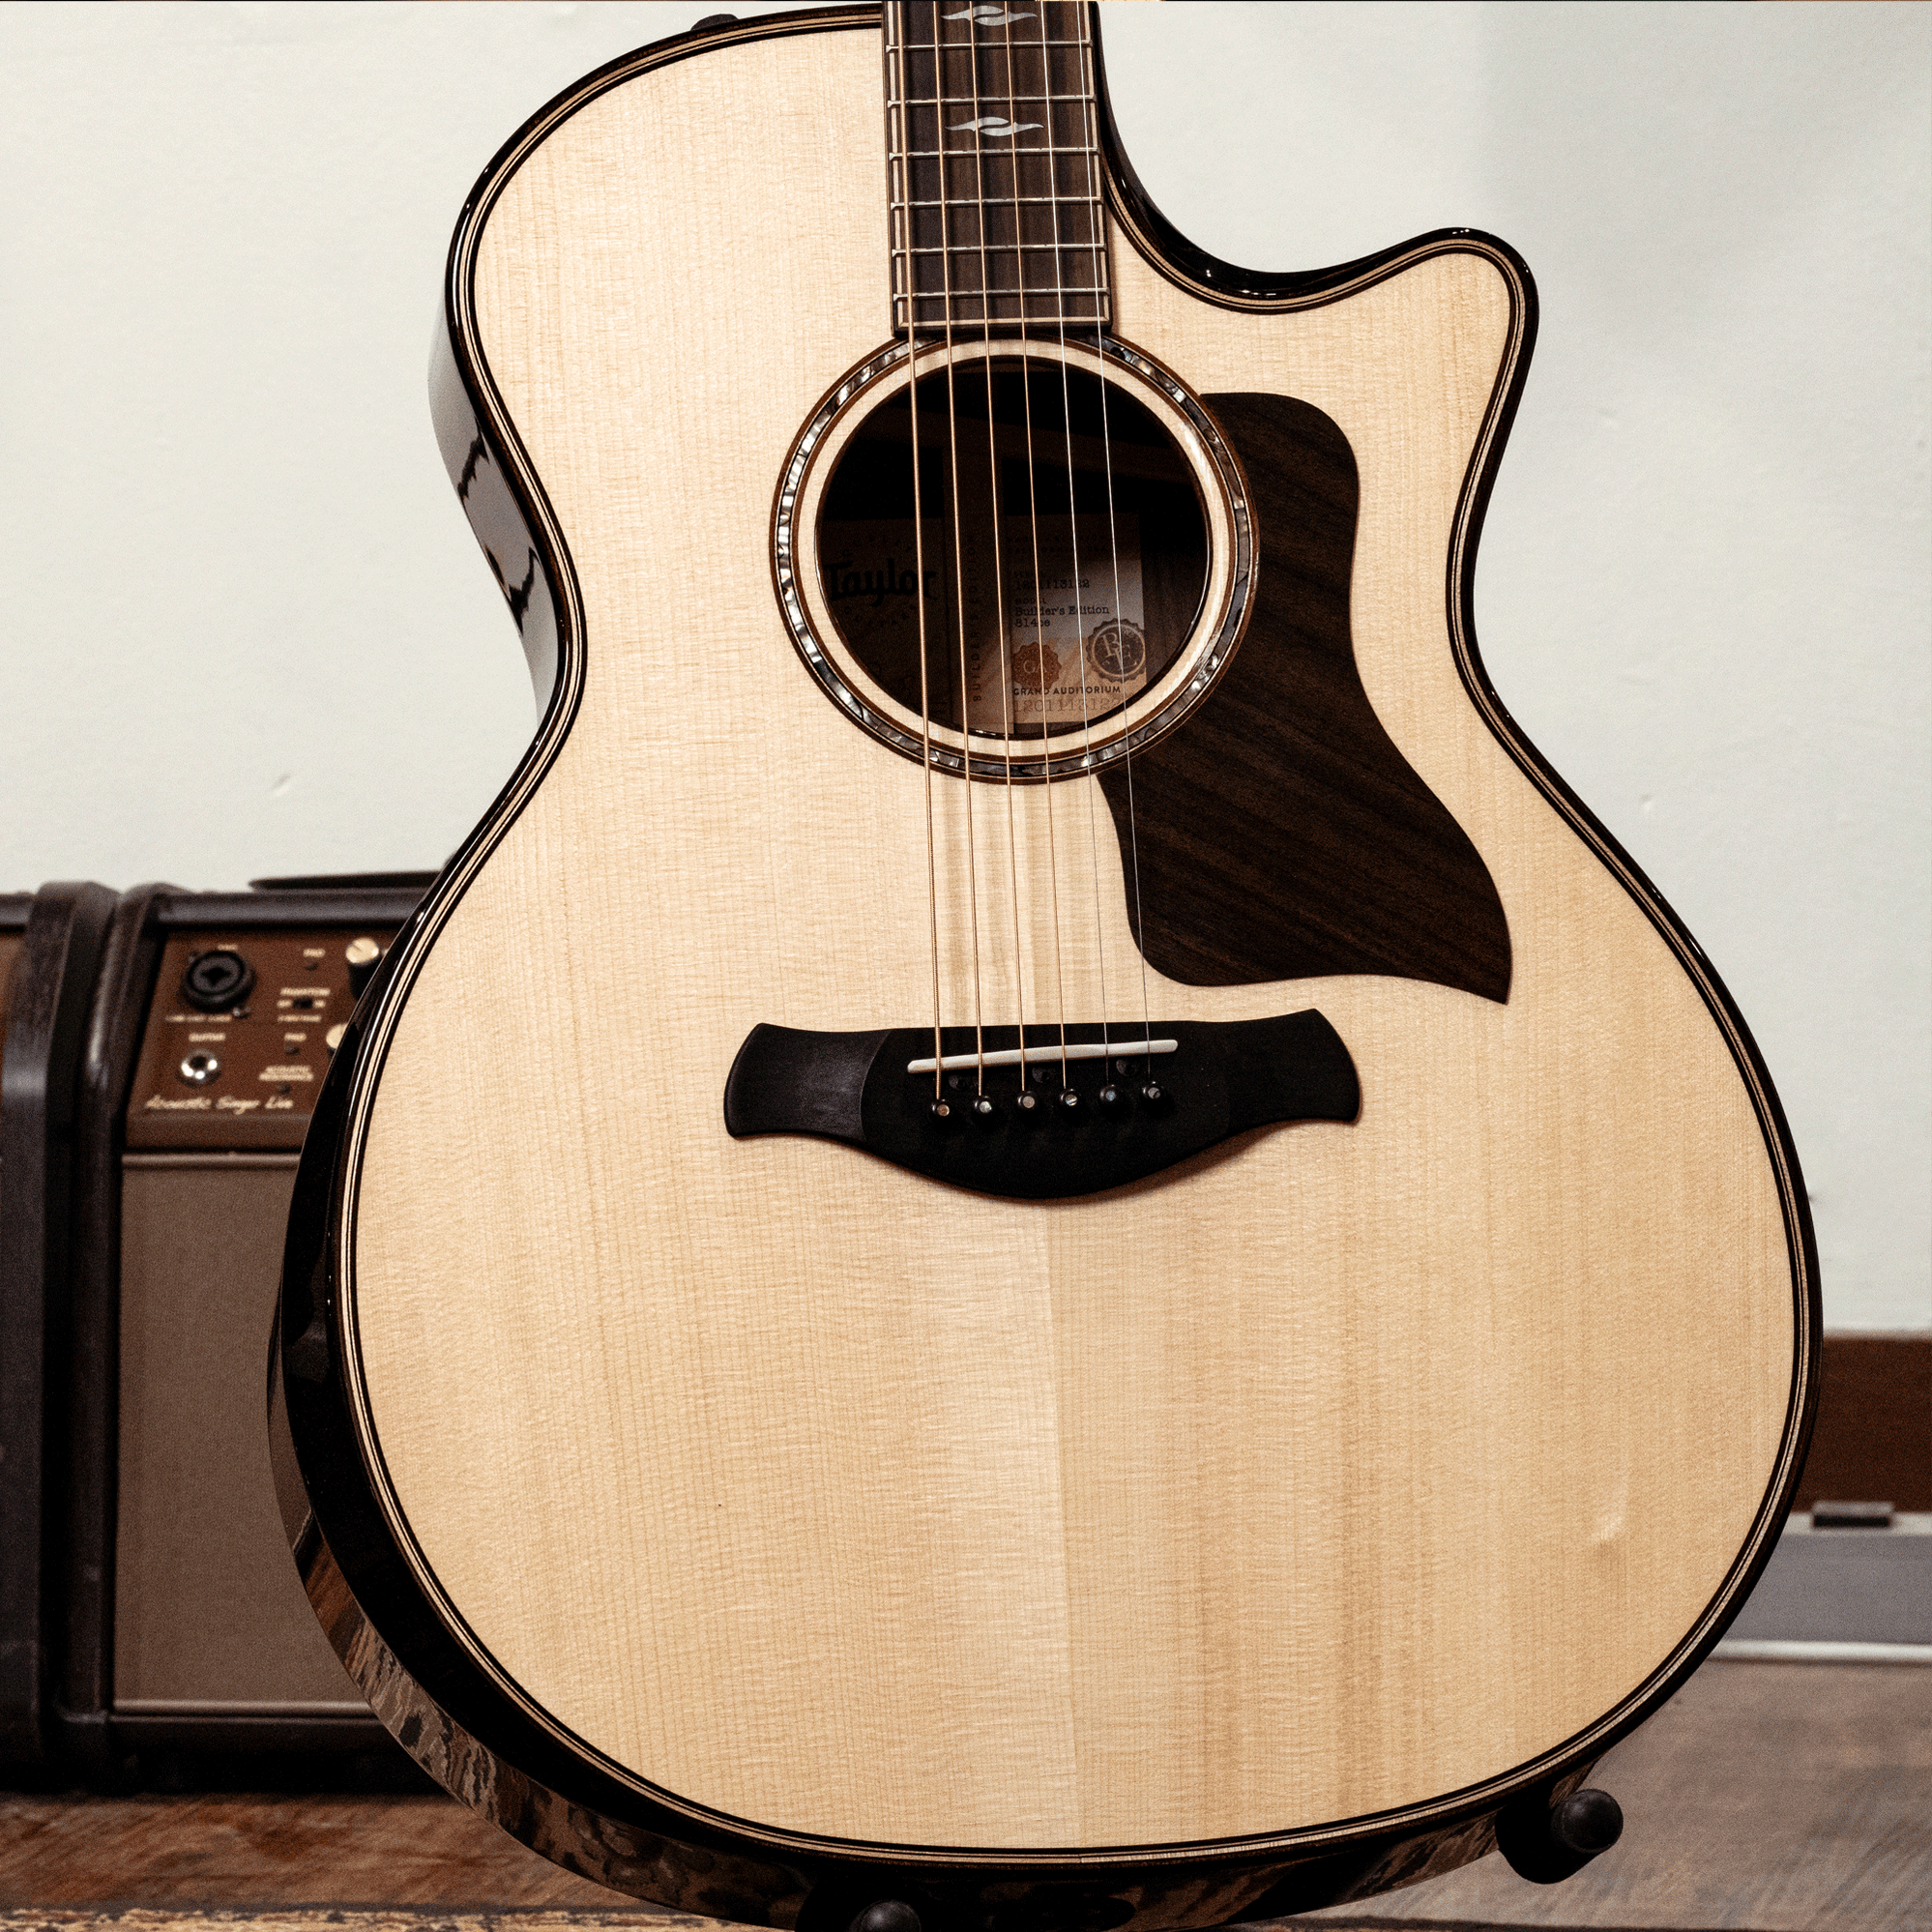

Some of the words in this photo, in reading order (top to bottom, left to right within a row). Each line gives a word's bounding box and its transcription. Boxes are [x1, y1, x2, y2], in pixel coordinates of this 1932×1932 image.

[823, 558, 937, 607] Taylor
[1015, 605, 1066, 617] Builder's
[1068, 605, 1110, 616] Edition
[1013, 687, 1050, 696] GRAND
[1052, 685, 1122, 695] AUDITORIUM
